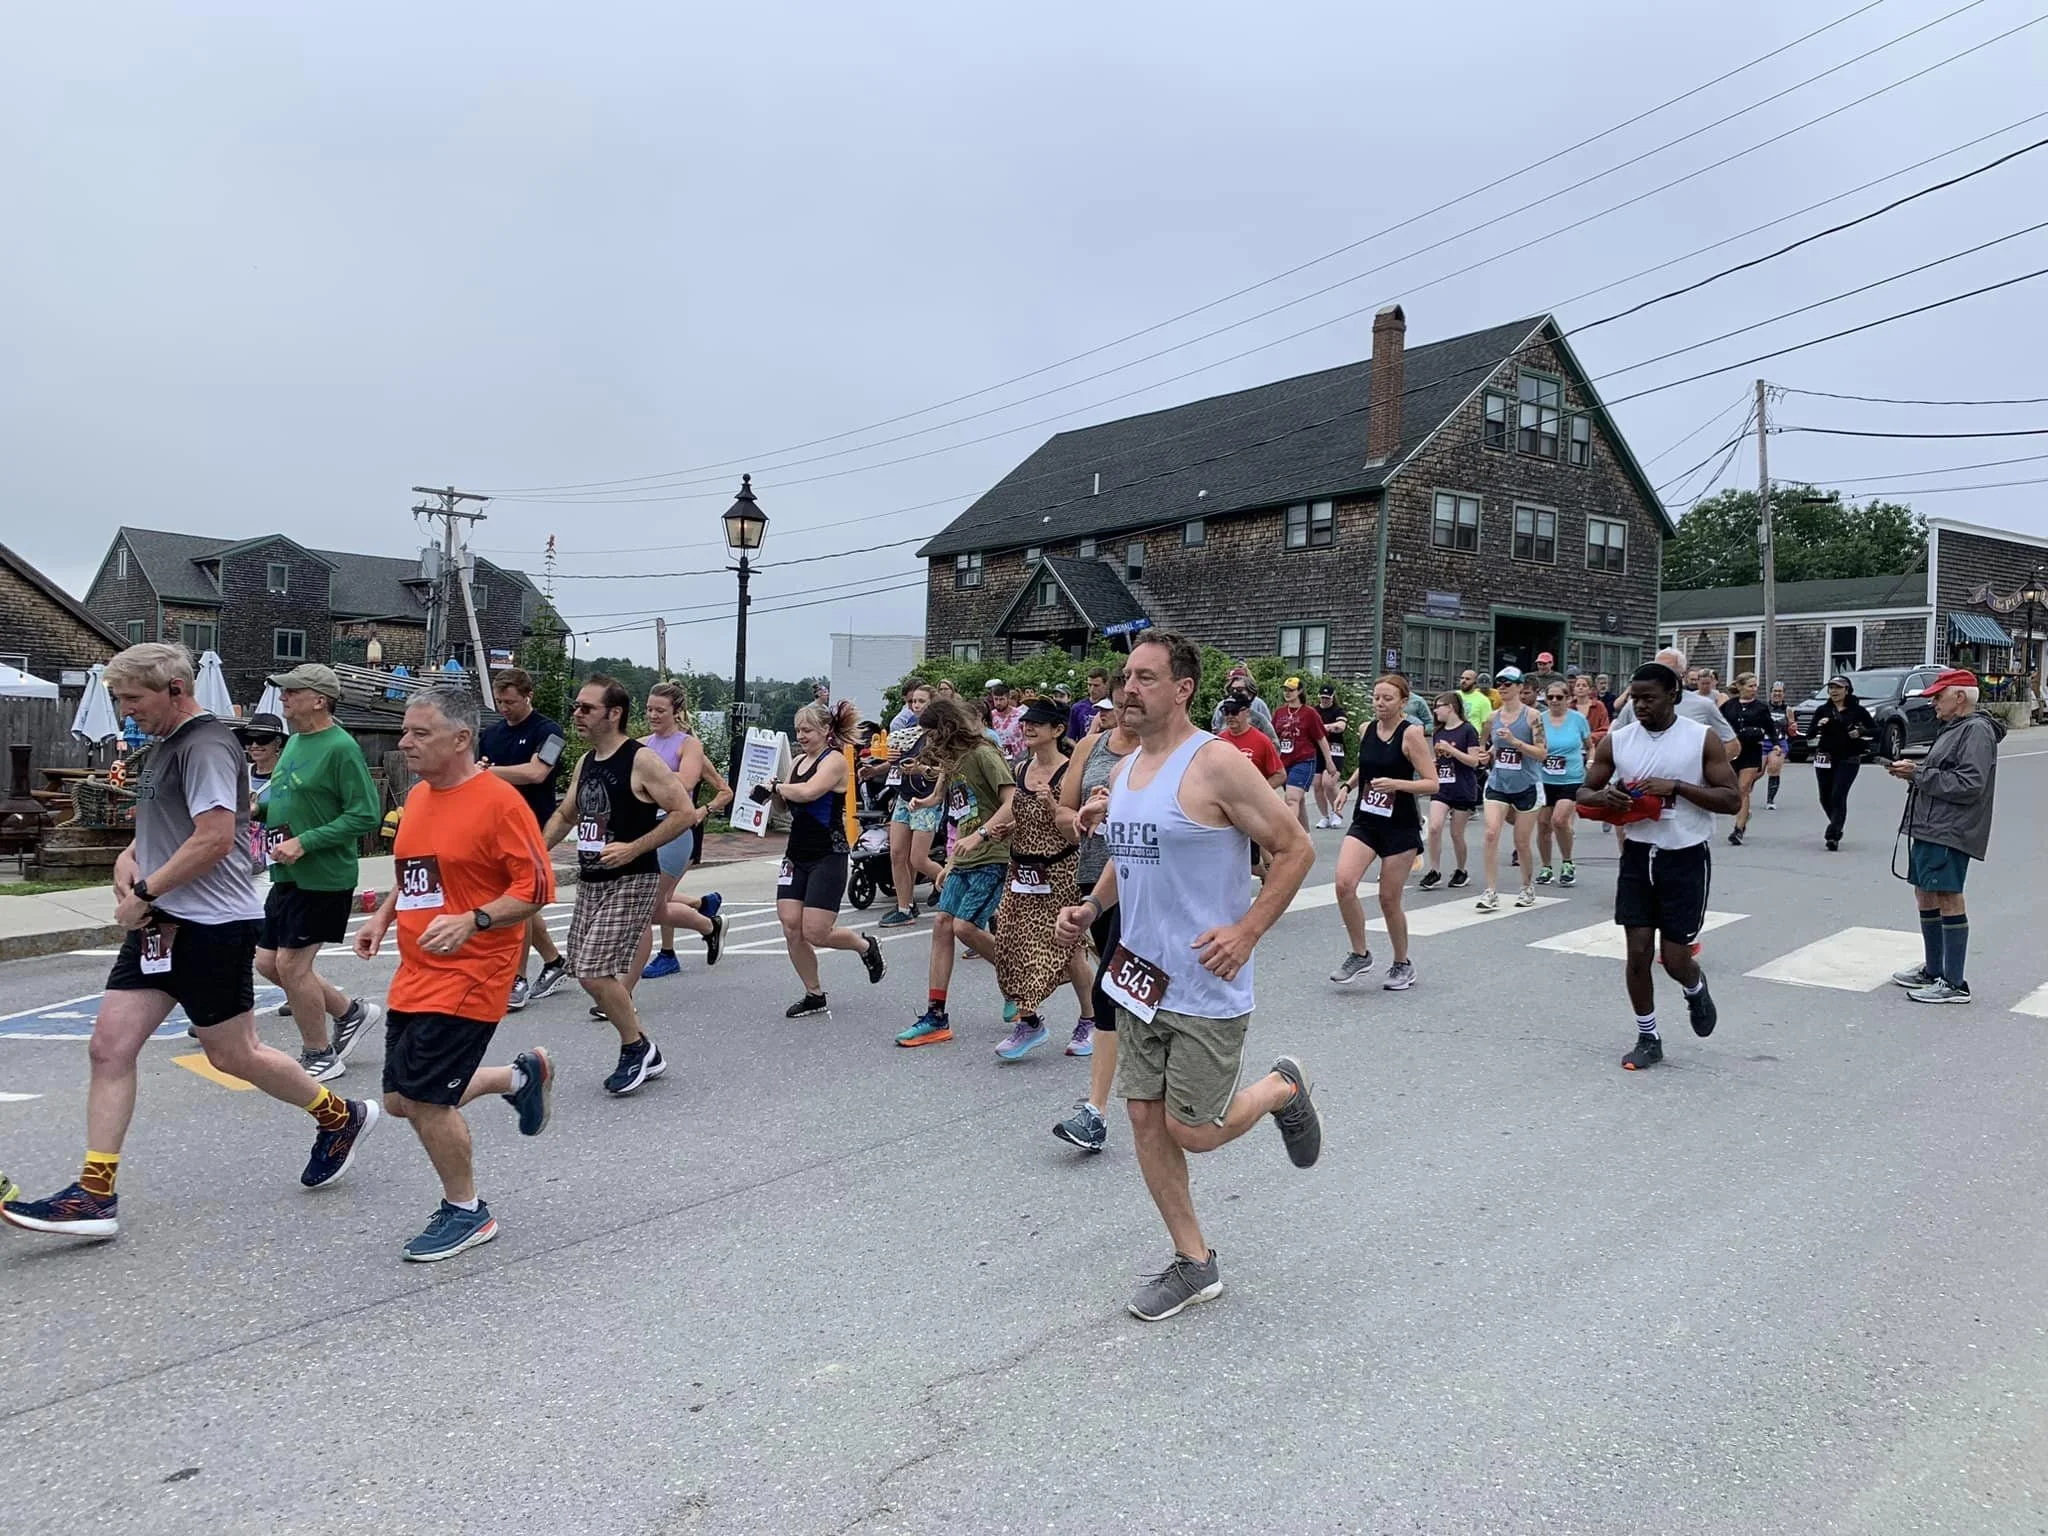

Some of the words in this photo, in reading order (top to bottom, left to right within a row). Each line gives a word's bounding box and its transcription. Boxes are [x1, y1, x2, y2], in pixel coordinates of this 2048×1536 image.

[1500, 752, 1516, 763] 571
[1367, 790, 1388, 807] 592
[580, 822, 598, 840] 570
[403, 868, 428, 894] 548
[1018, 869, 1040, 884] 550
[1117, 961, 1155, 1000] 545
